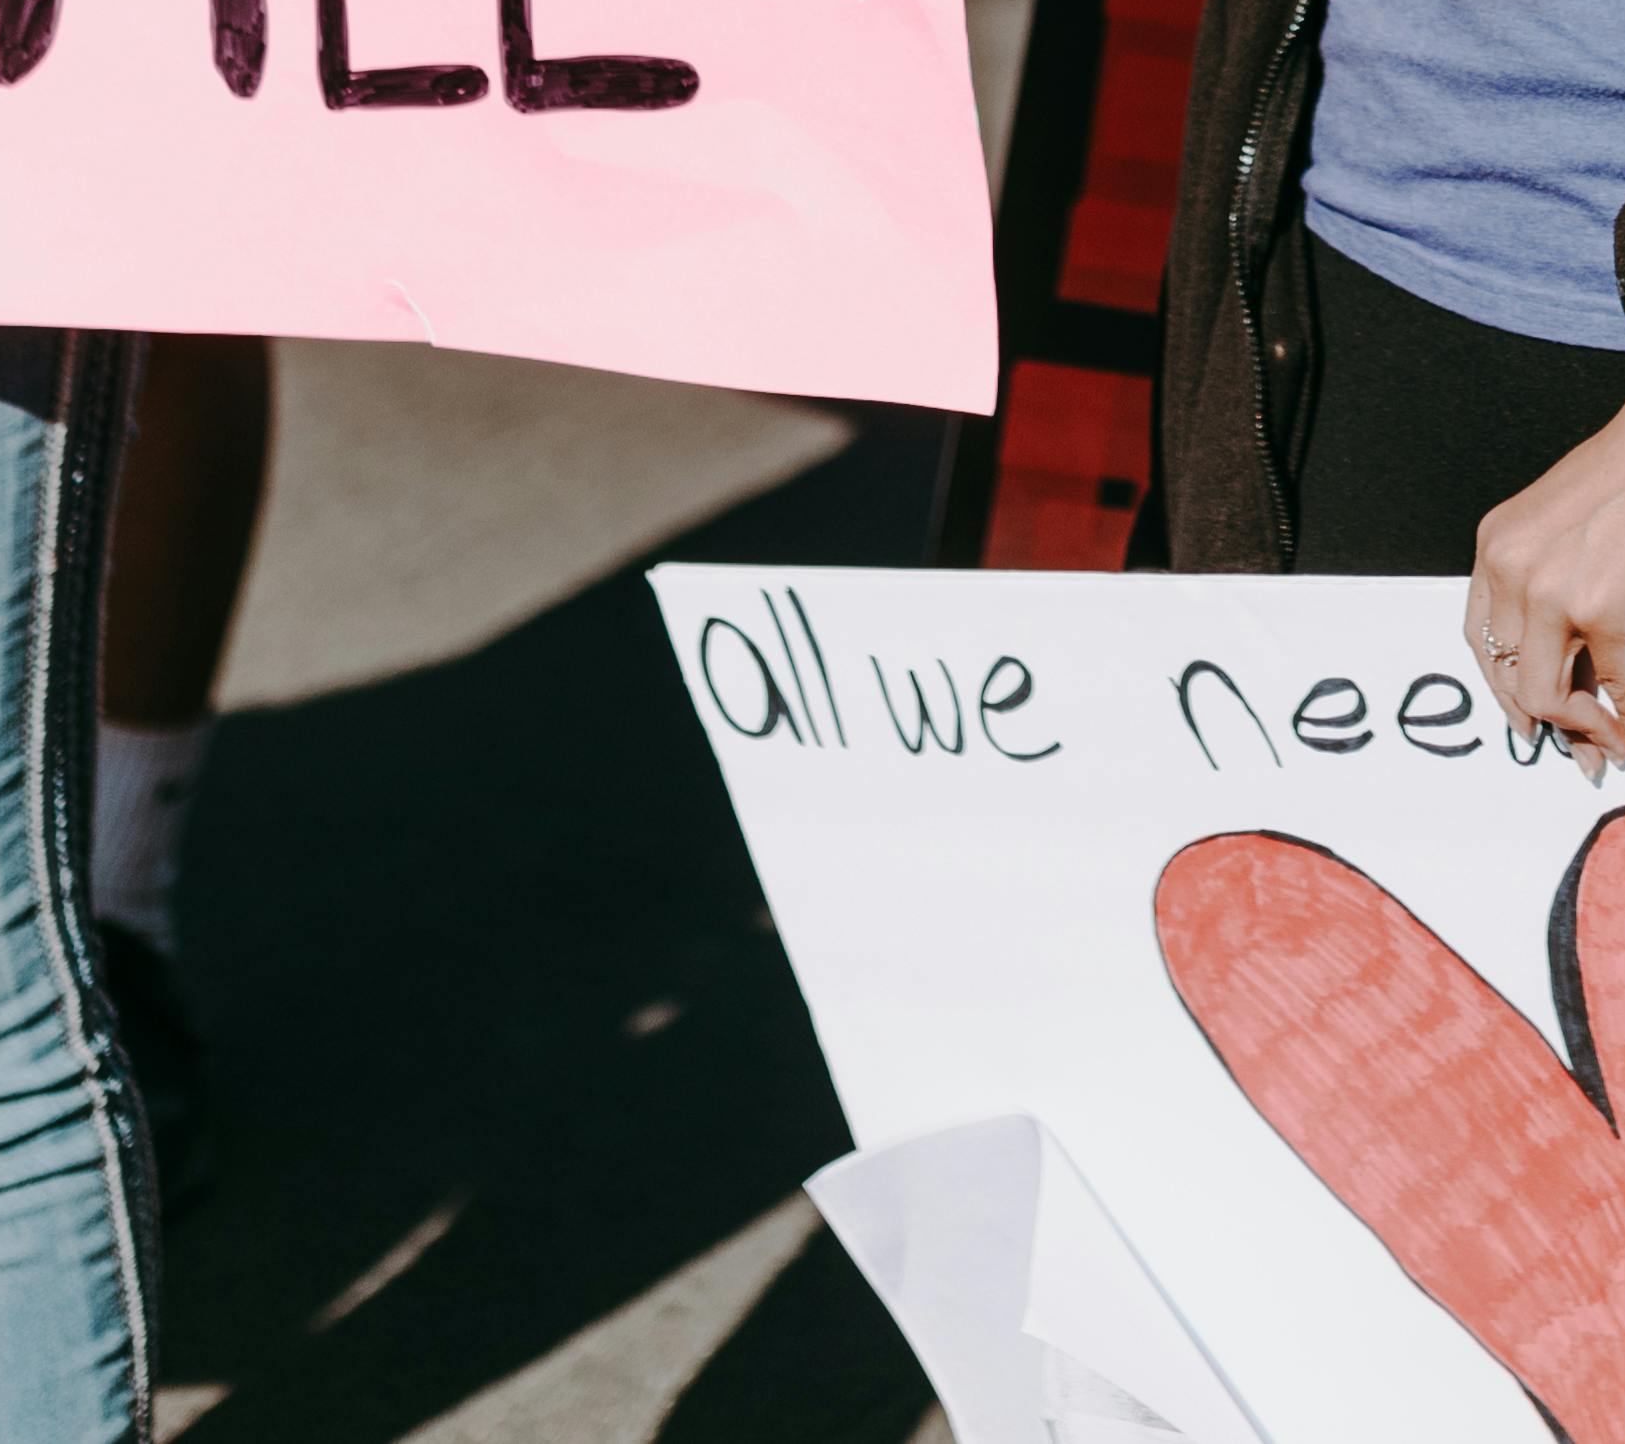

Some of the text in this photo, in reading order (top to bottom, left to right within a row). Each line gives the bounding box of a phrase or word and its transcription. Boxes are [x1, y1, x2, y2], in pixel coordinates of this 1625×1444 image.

[699, 586, 848, 749] all
[870, 655, 1062, 762] we
[1169, 658, 1577, 770] nee
